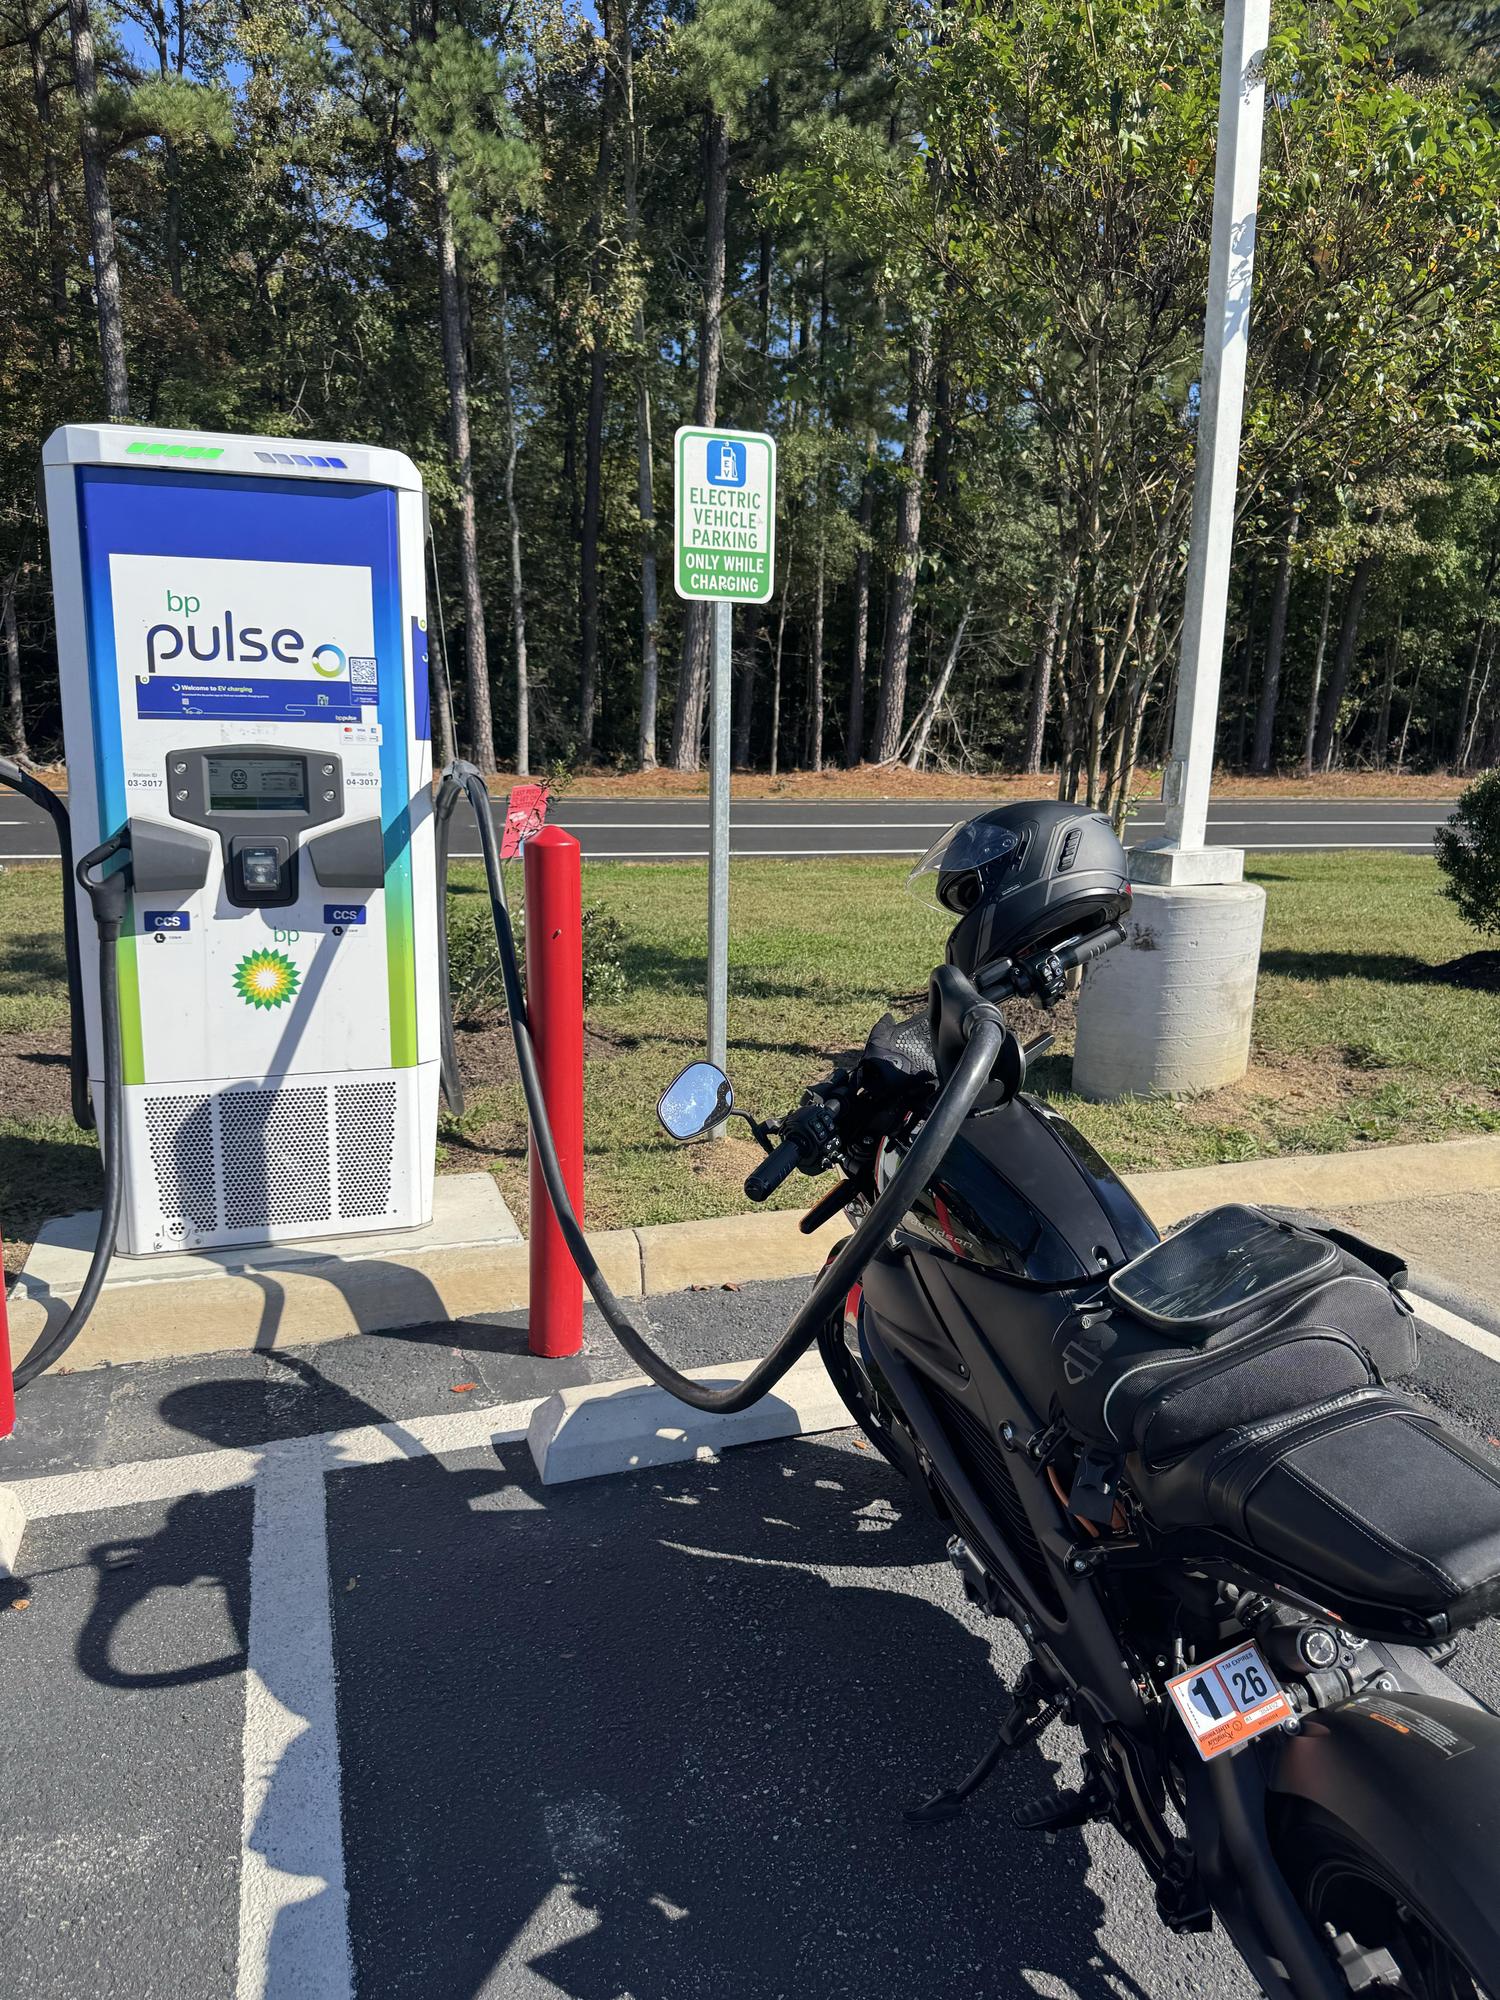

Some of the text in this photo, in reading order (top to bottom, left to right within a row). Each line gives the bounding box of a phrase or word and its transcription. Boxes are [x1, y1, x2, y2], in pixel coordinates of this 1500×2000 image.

[690, 487, 761, 510] ELECTRIC
[694, 508, 757, 529] VEHICLE
[692, 529, 758, 550] PARKING
[685, 553, 765, 574] ONLY WHILE
[690, 573, 759, 593] CHARGING
[167, 589, 201, 618] bp
[146, 610, 304, 674] pulse
[227, 686, 253, 694] charging
[127, 779, 163, 787] 03-3017
[346, 778, 379, 786] 04-3017
[154, 916, 181, 927] CCS
[332, 910, 358, 920] CCS
[274, 925, 300, 946] bp
[1231, 1652, 1254, 1666] EXPIRES
[1231, 1666, 1268, 1705] 26
[1191, 1676, 1222, 1721] 1
